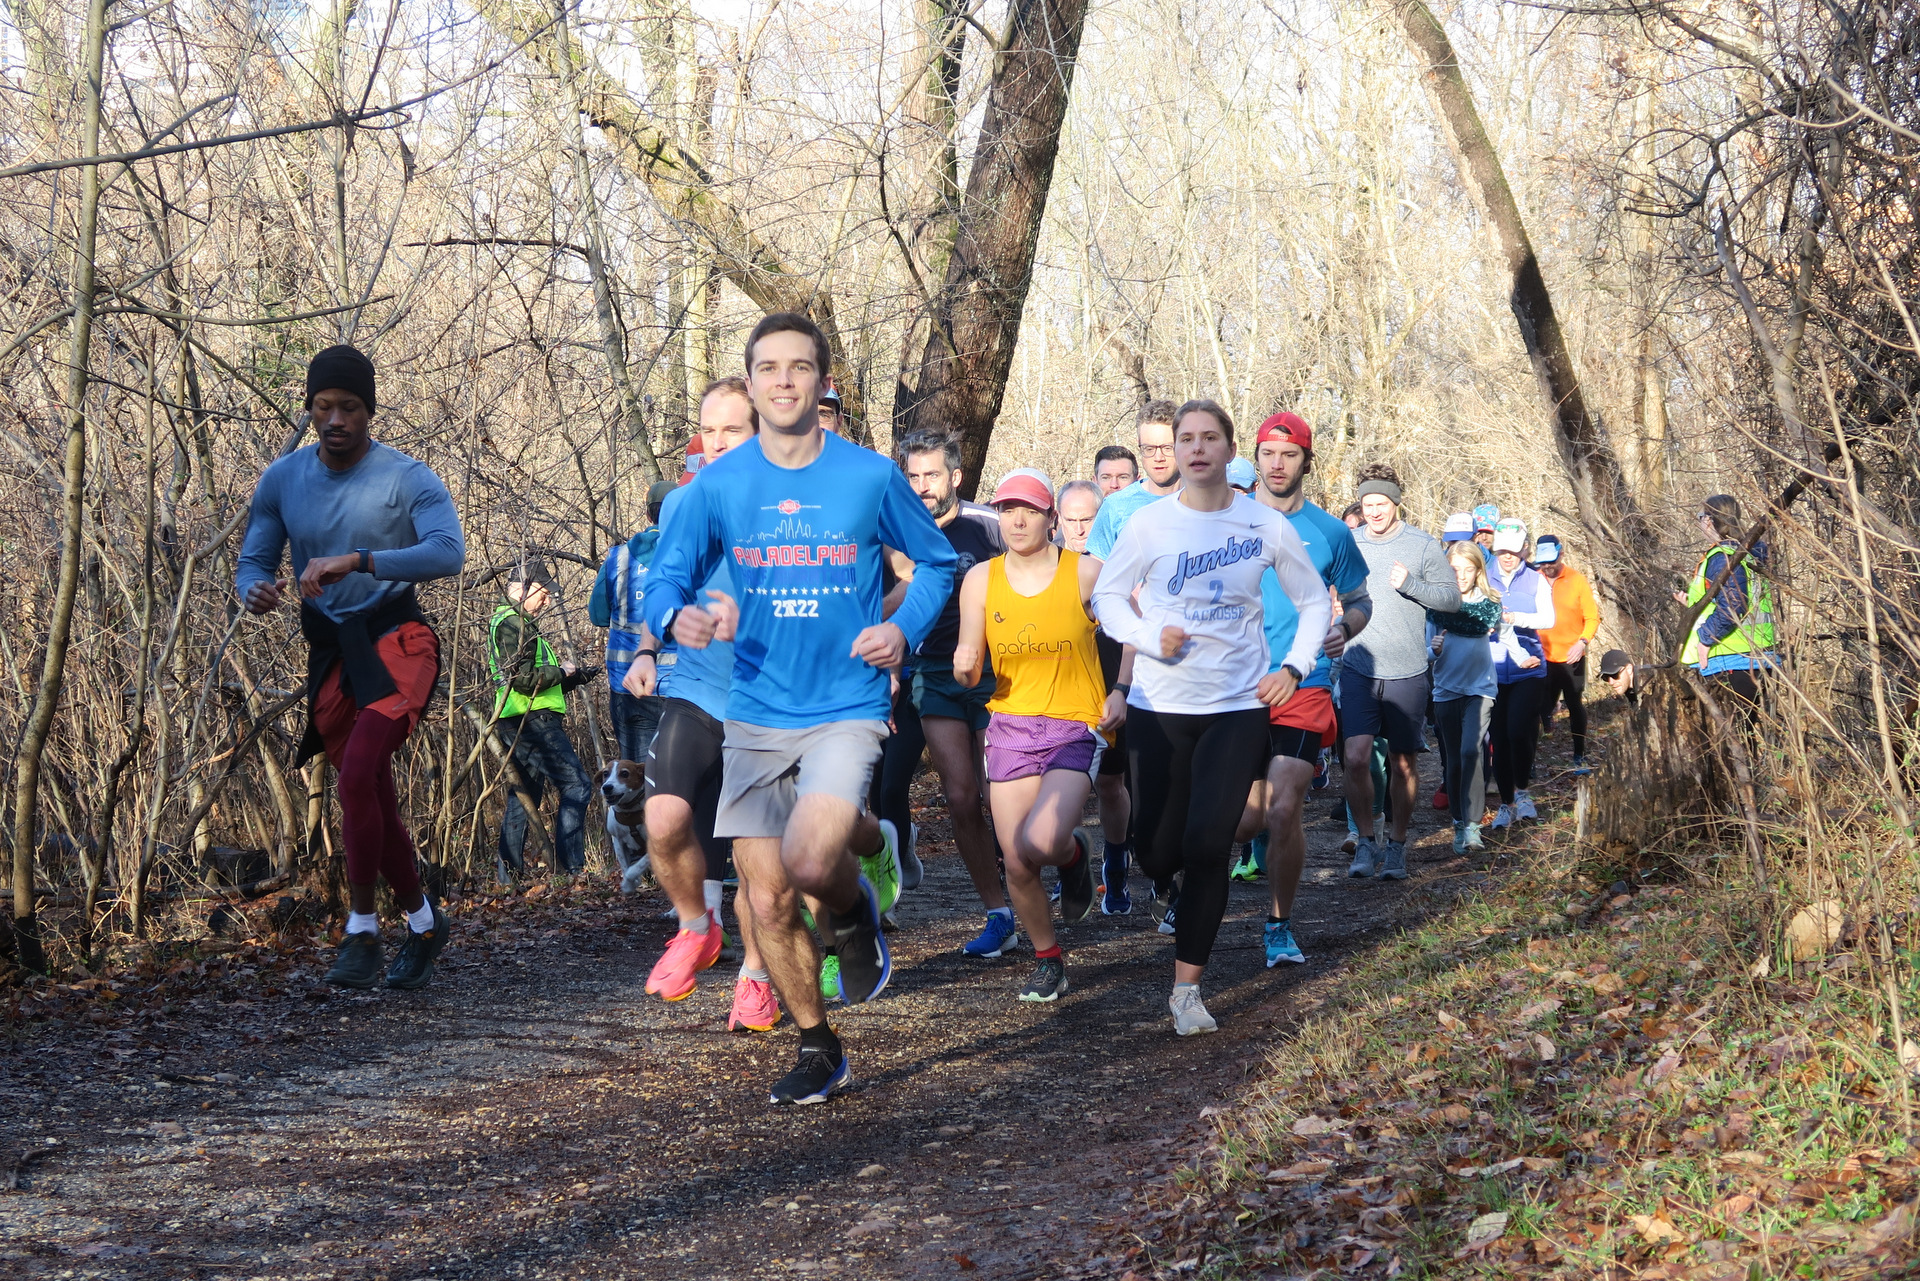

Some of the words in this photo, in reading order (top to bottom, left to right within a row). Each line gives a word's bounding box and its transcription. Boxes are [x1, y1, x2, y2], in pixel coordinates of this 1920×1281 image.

[733, 543, 858, 568] PHILADELPHIA
[1167, 536, 1263, 595] Jumbos
[1209, 580, 1224, 605] 2
[1183, 606, 1246, 621] LACROSSE
[997, 631, 1072, 656] parkrun
